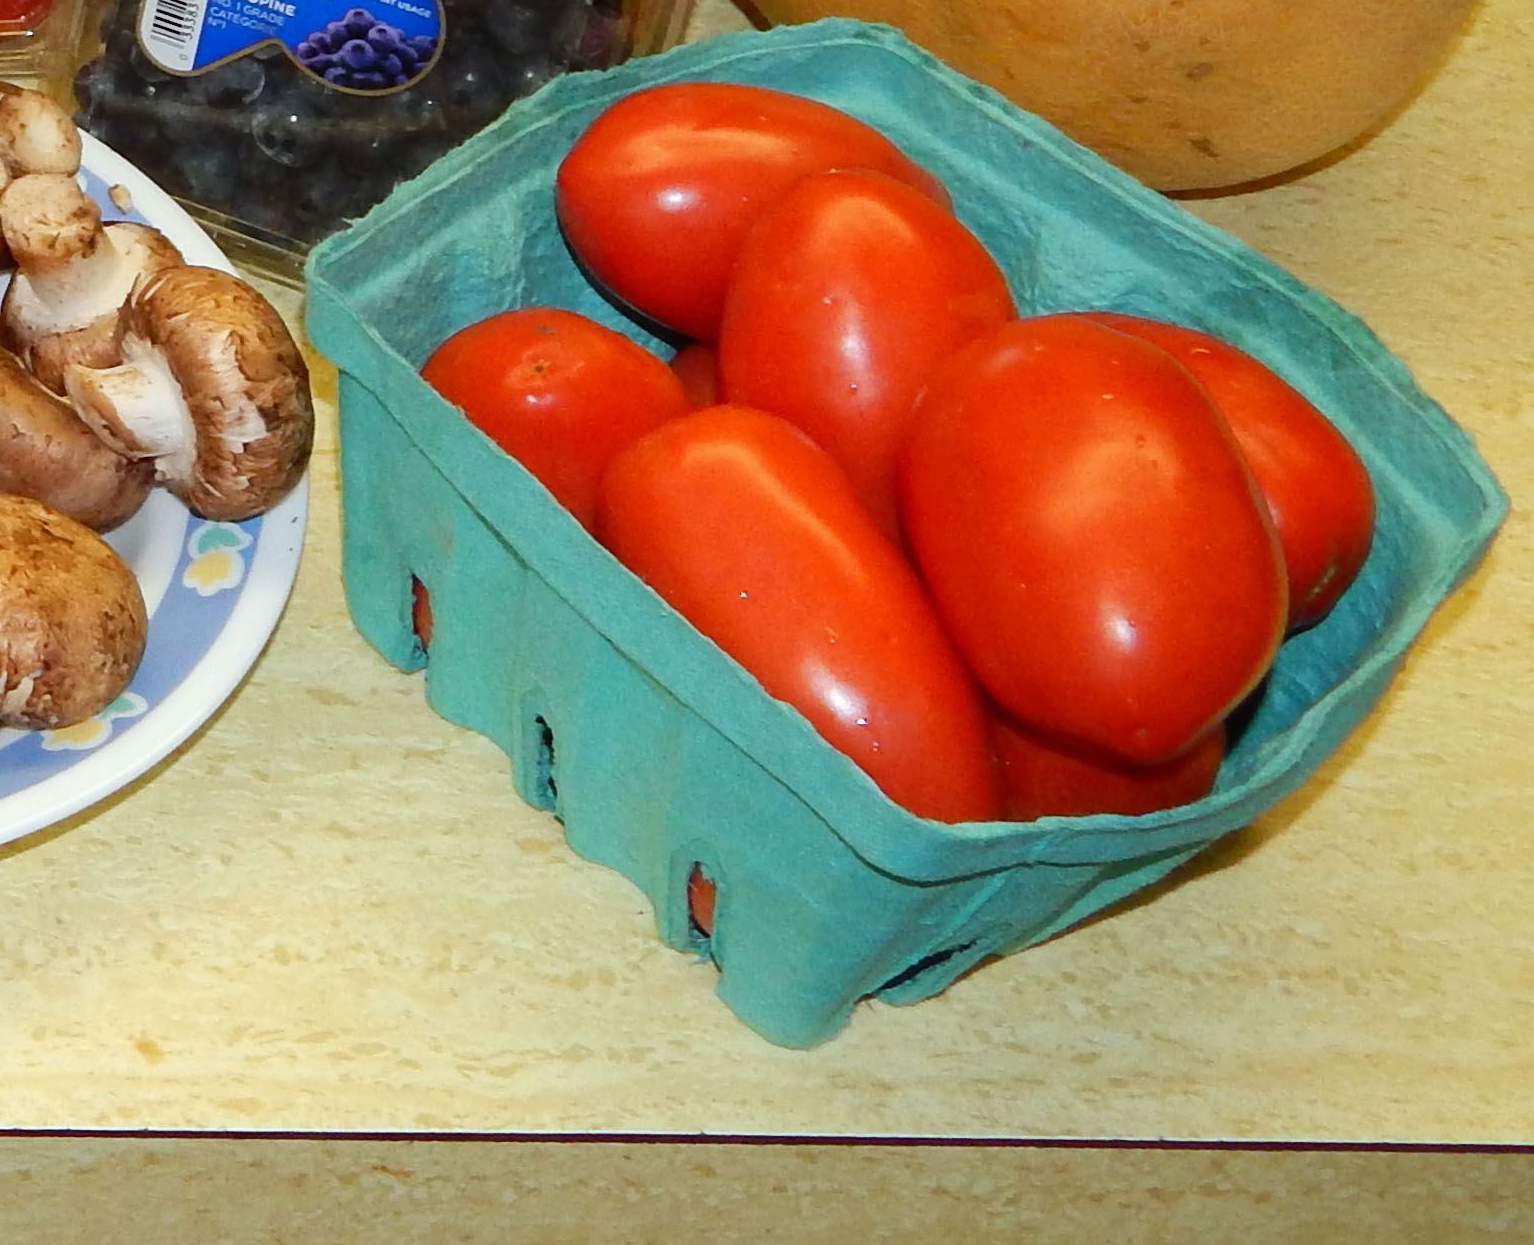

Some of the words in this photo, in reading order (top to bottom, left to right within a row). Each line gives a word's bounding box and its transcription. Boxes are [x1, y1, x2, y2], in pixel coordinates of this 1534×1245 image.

[243, 4, 285, 27] GRADE
[397, 0, 432, 19] USAGE
[180, 2, 200, 41] 33383
